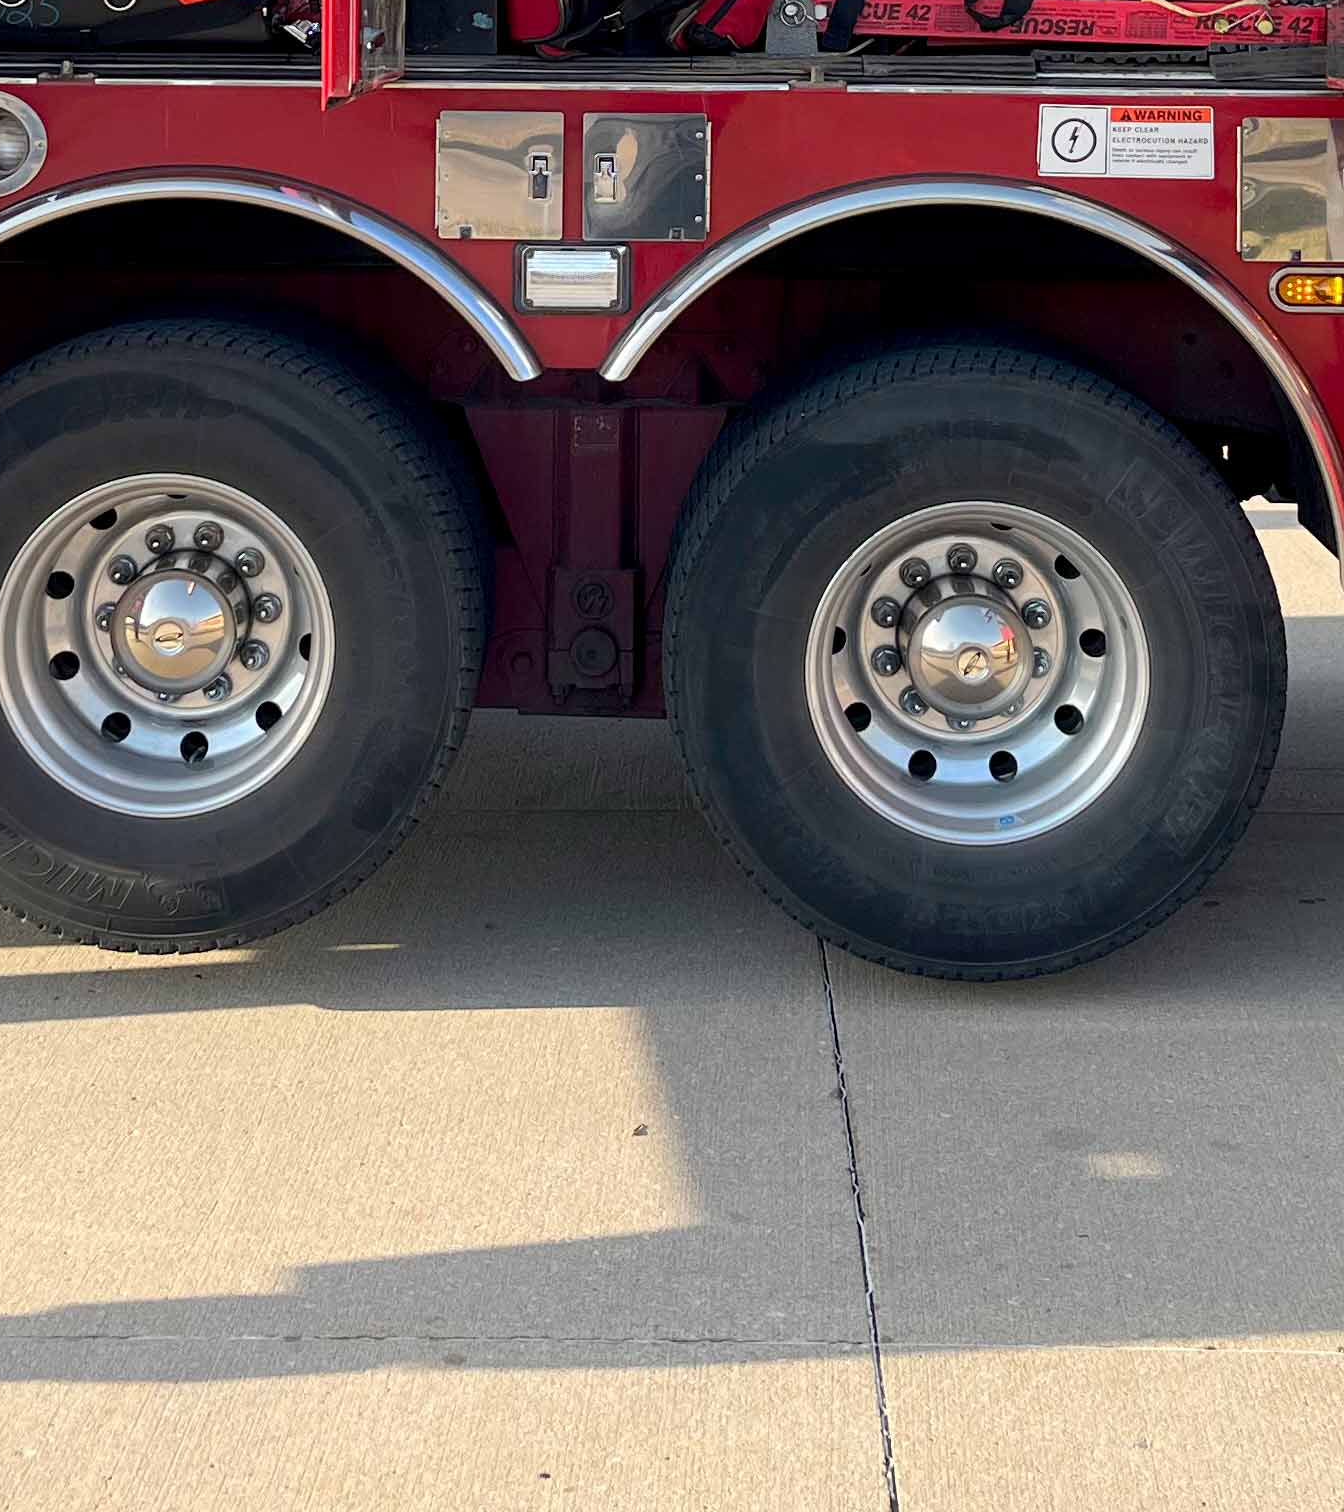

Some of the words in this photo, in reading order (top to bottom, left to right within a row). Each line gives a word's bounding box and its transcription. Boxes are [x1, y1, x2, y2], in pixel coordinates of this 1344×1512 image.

[906, 5, 931, 22] 42
[1287, 17, 1314, 34] 42
[1133, 110, 1204, 121] WARNING
[1111, 126, 1133, 134] KEEP
[1134, 126, 1160, 134] CLEAR
[1111, 136, 1177, 145] ELECTROCUTION
[1177, 138, 1210, 146] HAZARD
